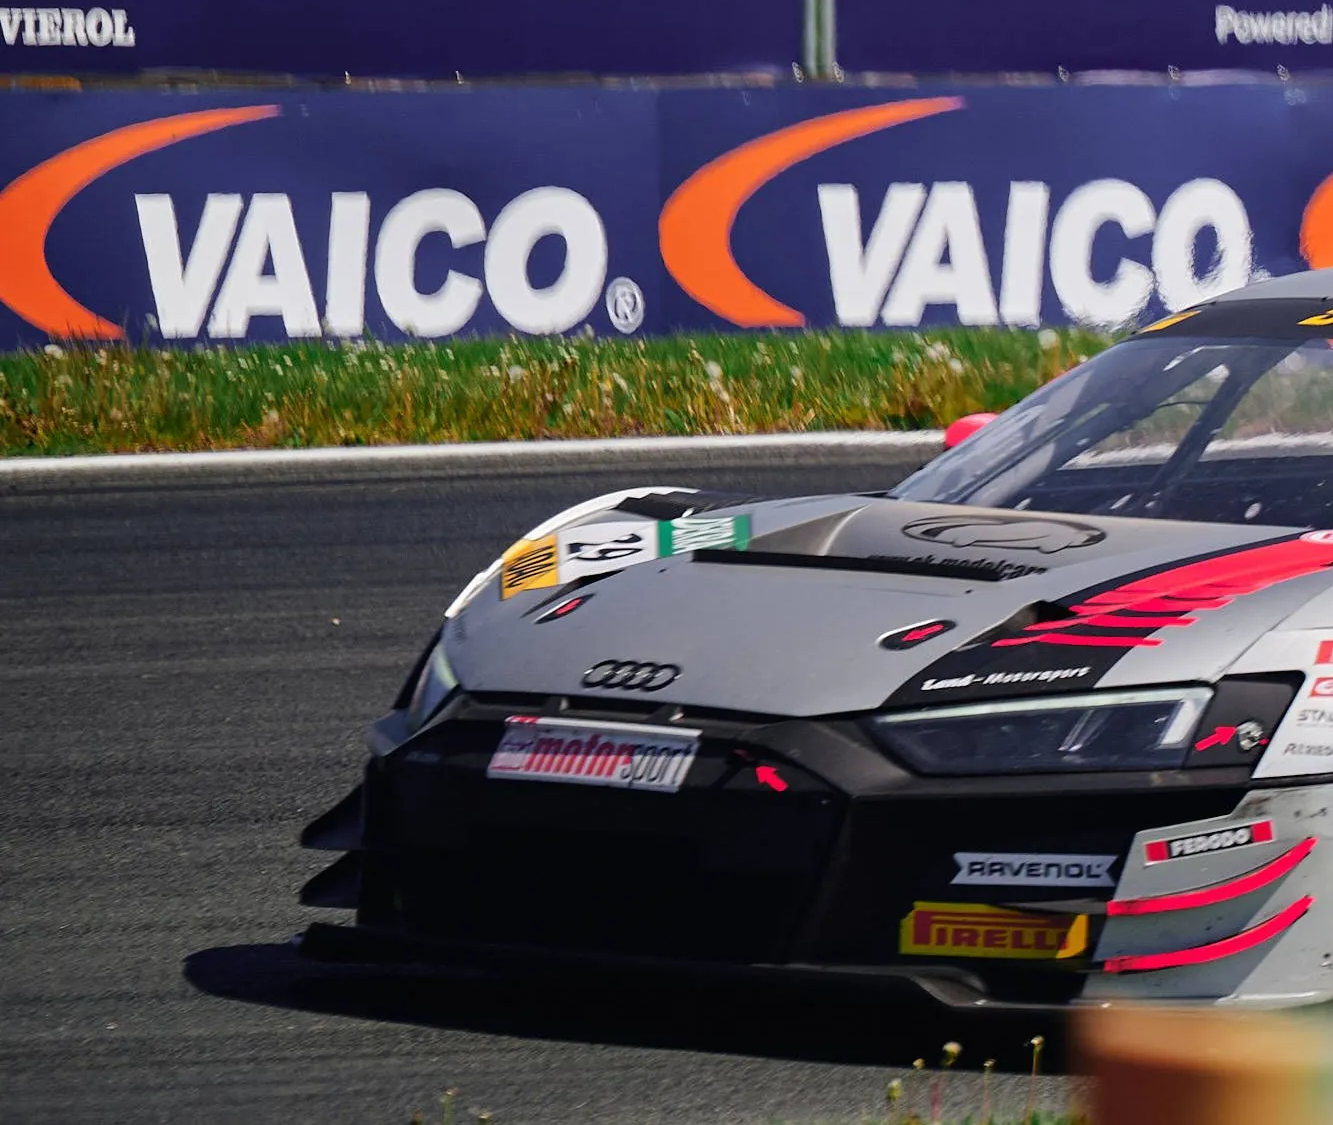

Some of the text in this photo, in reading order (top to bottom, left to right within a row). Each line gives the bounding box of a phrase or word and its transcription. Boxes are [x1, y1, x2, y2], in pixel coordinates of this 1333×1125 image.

[0, 7, 136, 47] VIEROL
[1214, 3, 1333, 45] Powered
[966, 860, 1101, 881] RAVENOL
[913, 908, 1070, 951] PIRELLI
